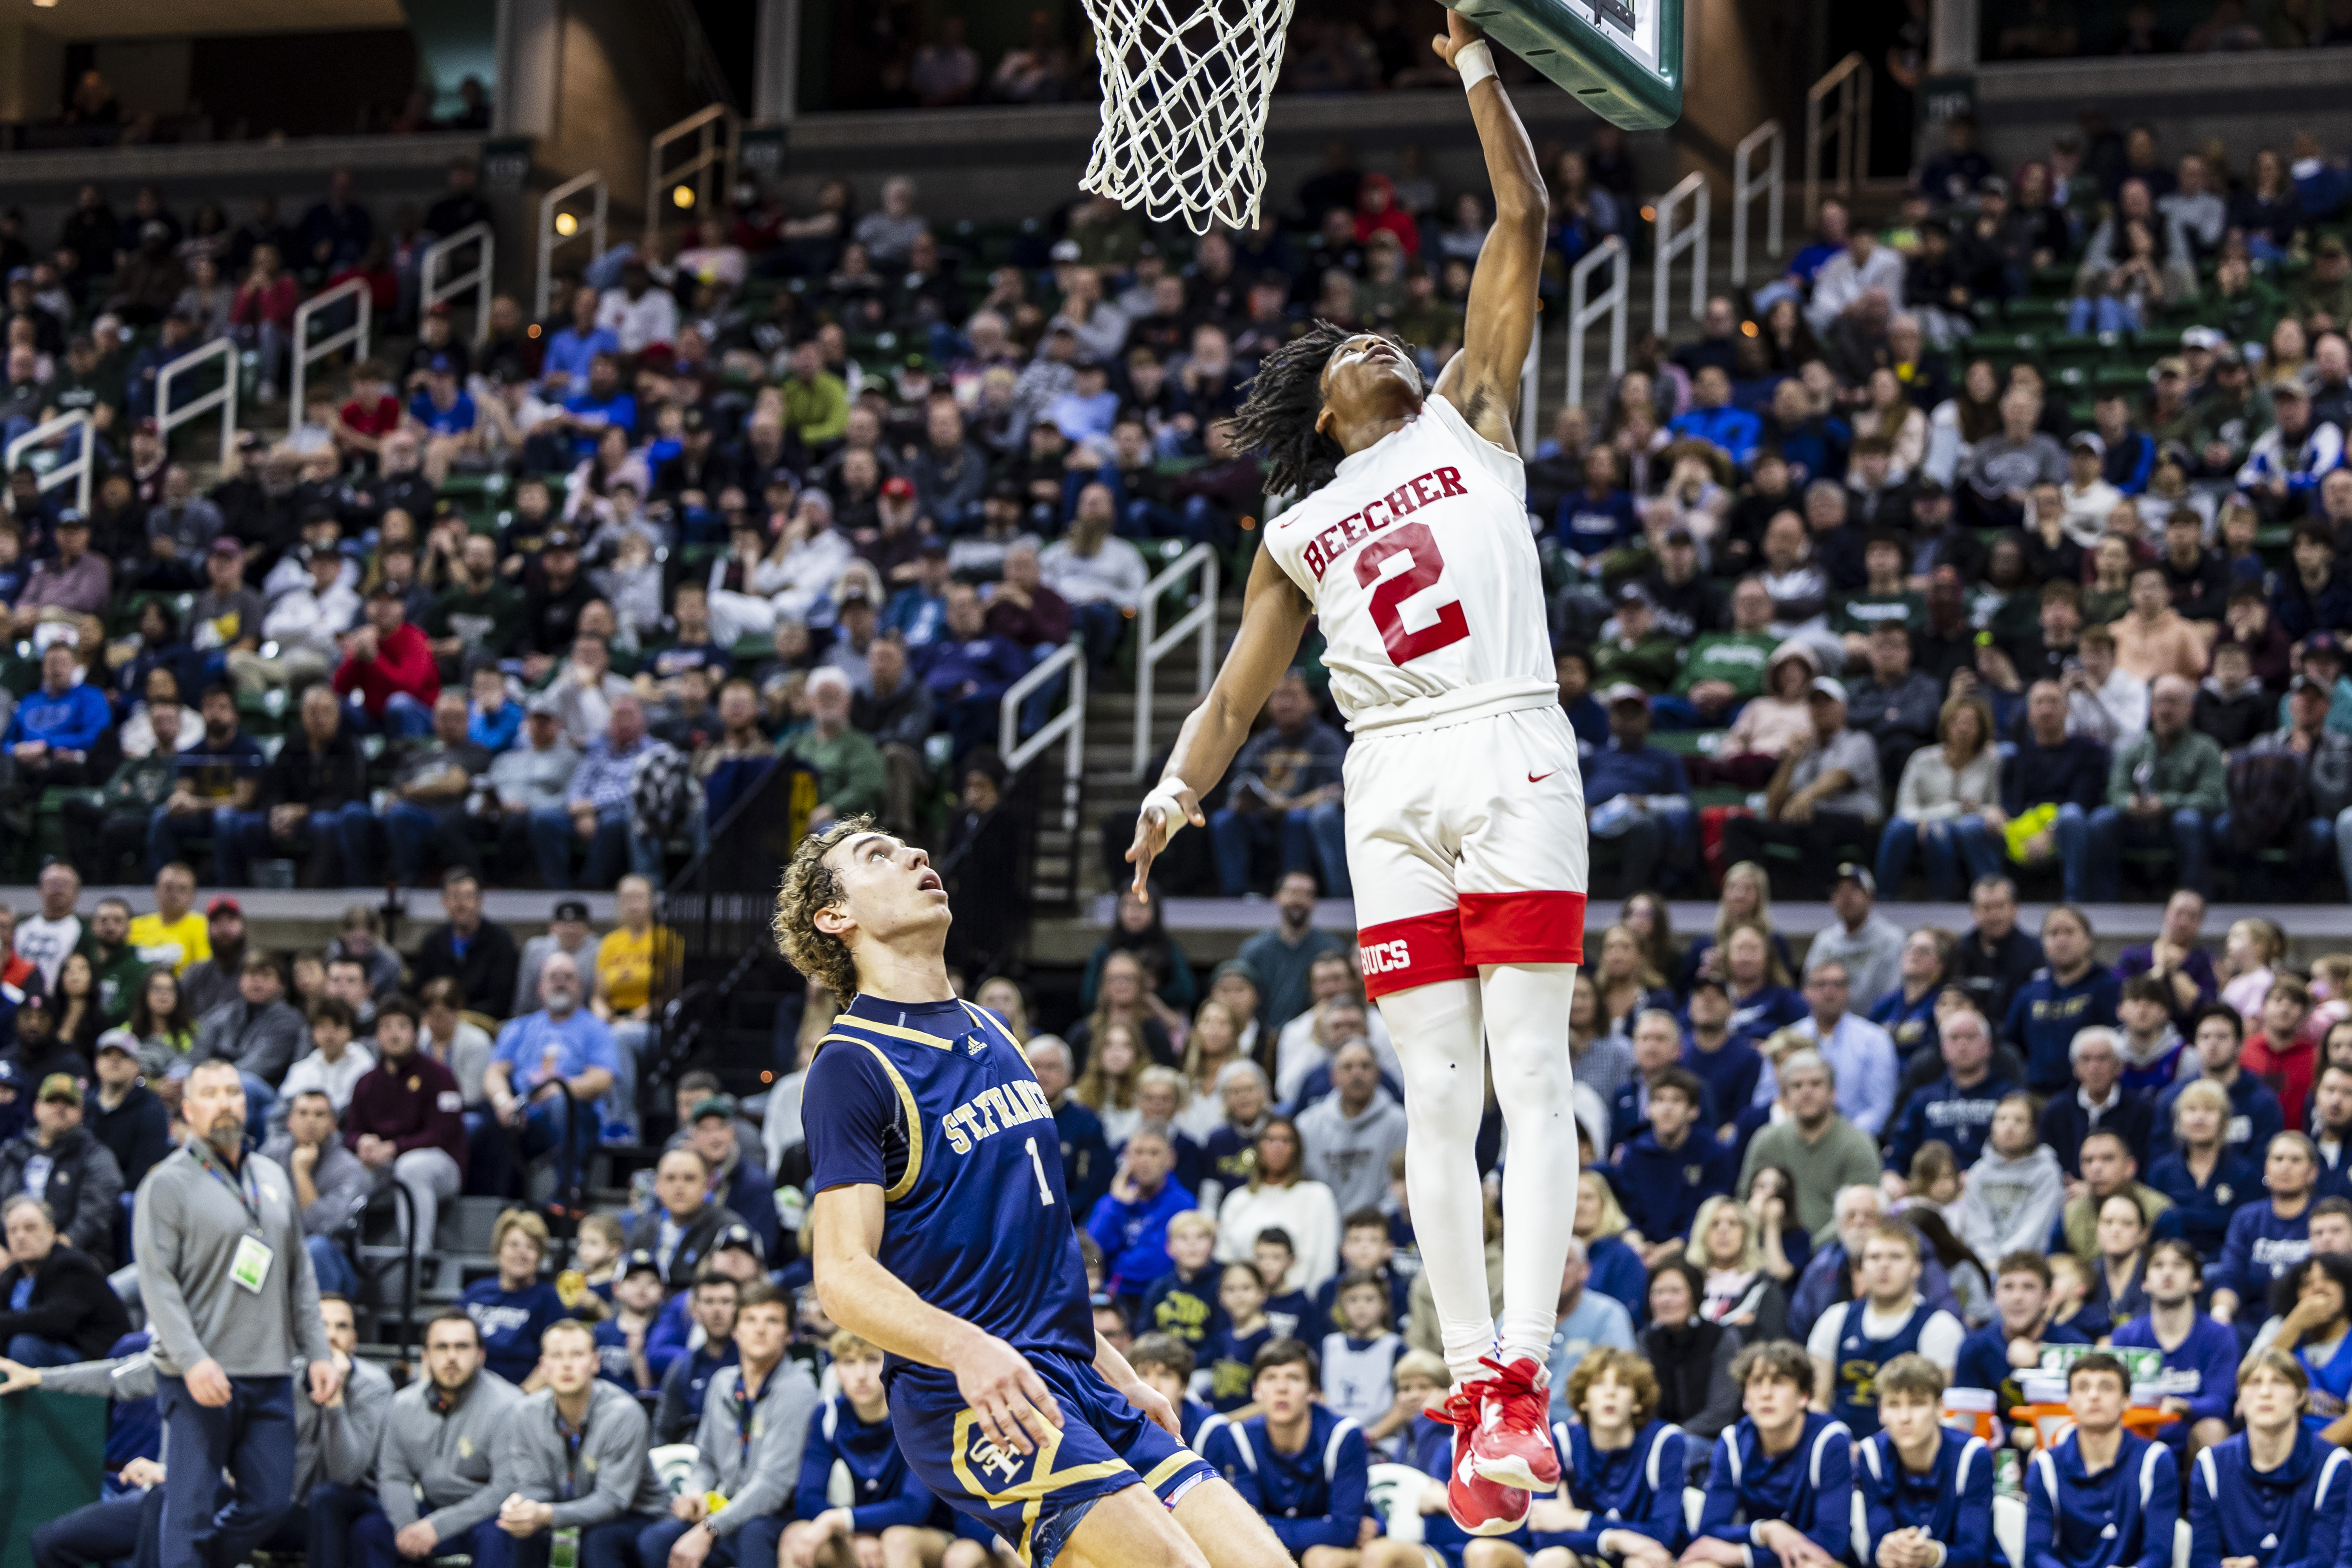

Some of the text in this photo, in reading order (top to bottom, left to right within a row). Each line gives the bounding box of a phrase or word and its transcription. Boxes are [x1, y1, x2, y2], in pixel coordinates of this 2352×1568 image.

[1303, 466, 1468, 583] BEECHER
[1353, 522, 1471, 667] 2
[1360, 939, 1411, 975] BUCS
[969, 1042, 988, 1055] adidas
[1025, 1137, 1055, 1205] 1
